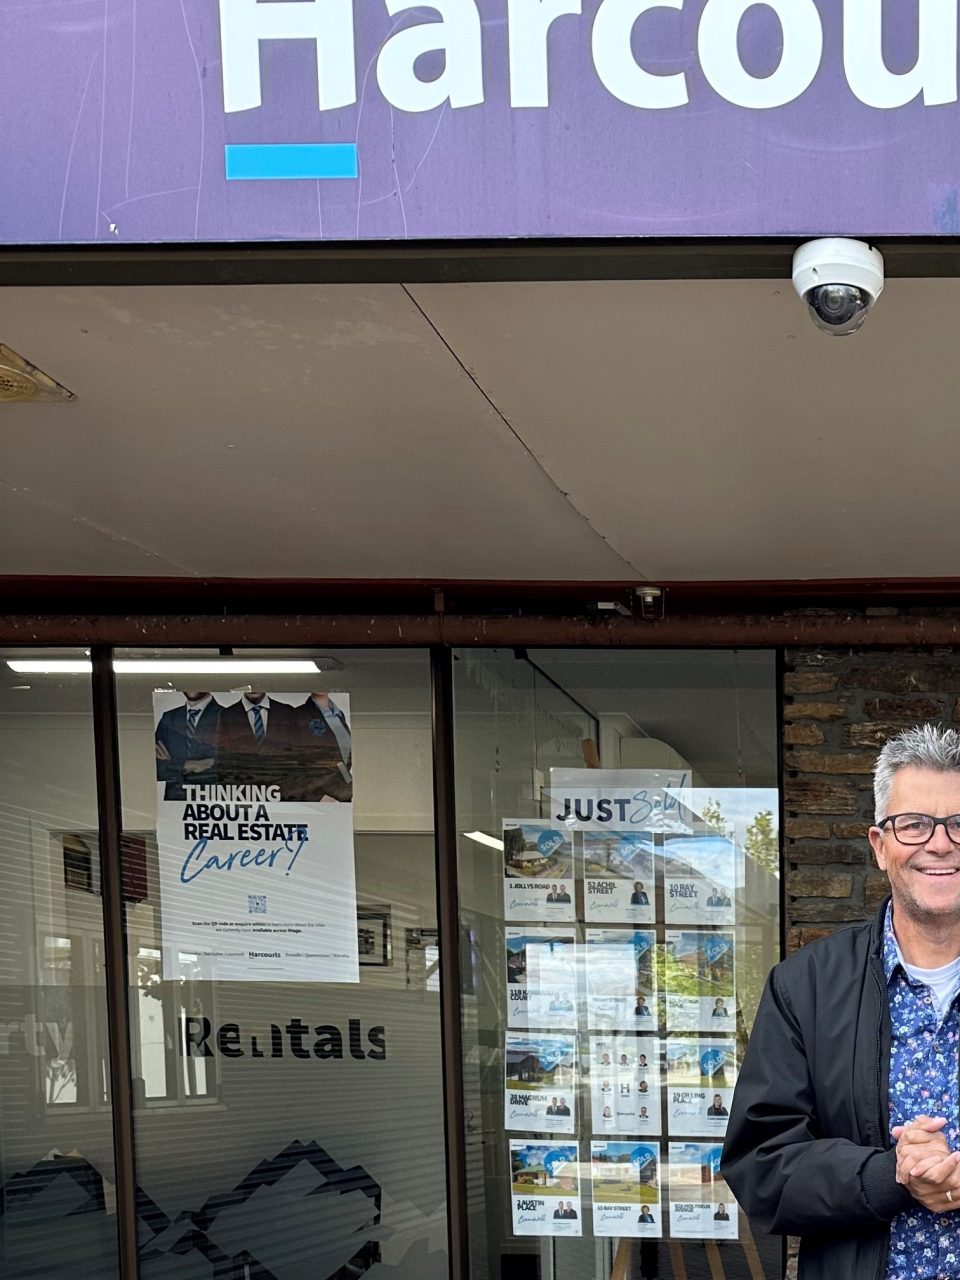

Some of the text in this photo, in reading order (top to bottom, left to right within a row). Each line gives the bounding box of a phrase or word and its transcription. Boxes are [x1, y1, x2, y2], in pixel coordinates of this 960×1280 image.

[182, 784, 281, 802] THINKING
[555, 773, 687, 825] JUST Sold
[182, 804, 270, 821] ABOUT A
[184, 823, 309, 841] REAL ESTATE
[540, 836, 560, 852] SOLD
[180, 827, 308, 884] Career?
[178, 1016, 388, 1061] Rentals
[703, 1055, 724, 1069] SOLD
[632, 1153, 651, 1167] SOLD
